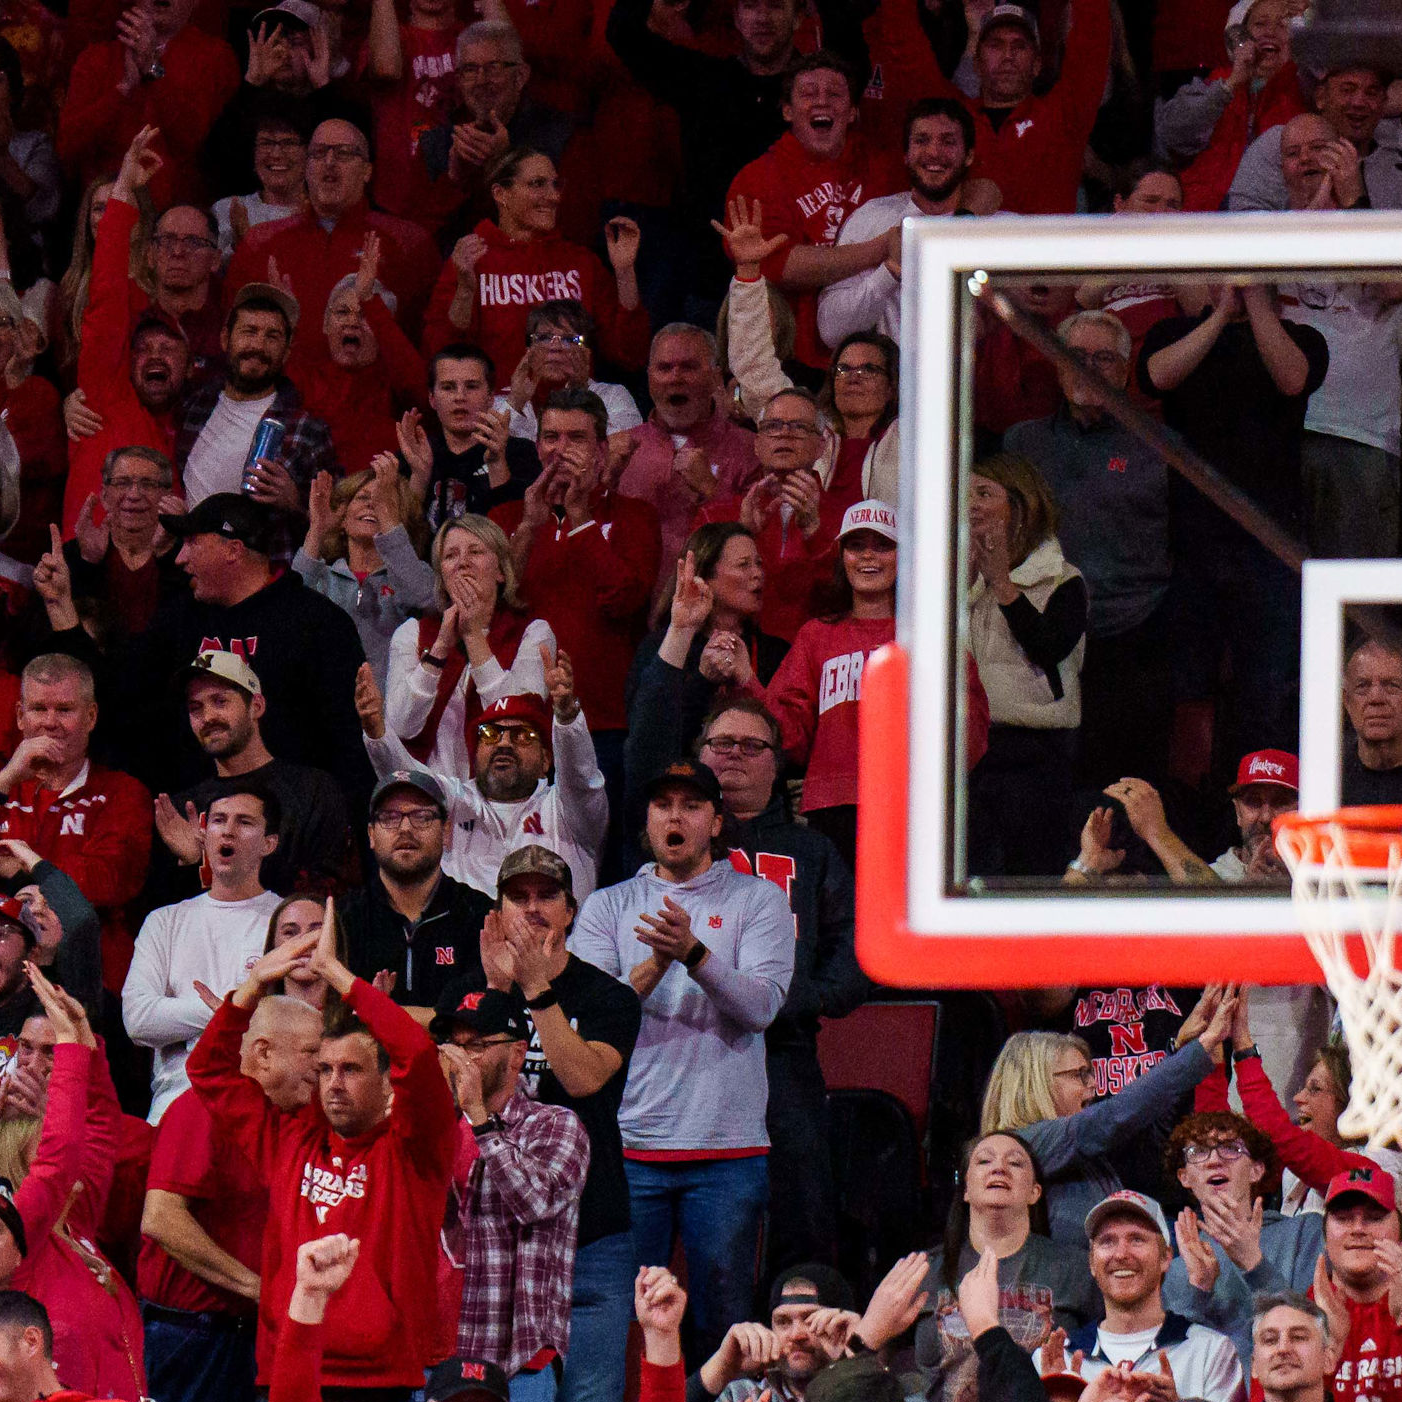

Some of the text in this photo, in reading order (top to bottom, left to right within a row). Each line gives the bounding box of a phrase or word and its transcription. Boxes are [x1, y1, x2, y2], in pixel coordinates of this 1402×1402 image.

[480, 269, 581, 307] HUSKERS
[848, 508, 897, 529] NEBRASKA
[494, 697, 509, 712] N
[58, 812, 84, 836] N
[522, 812, 542, 834] N
[434, 946, 455, 966] N
[1108, 1020, 1148, 1056] N
[1089, 1050, 1166, 1098] USKE
[459, 1361, 486, 1382] N
